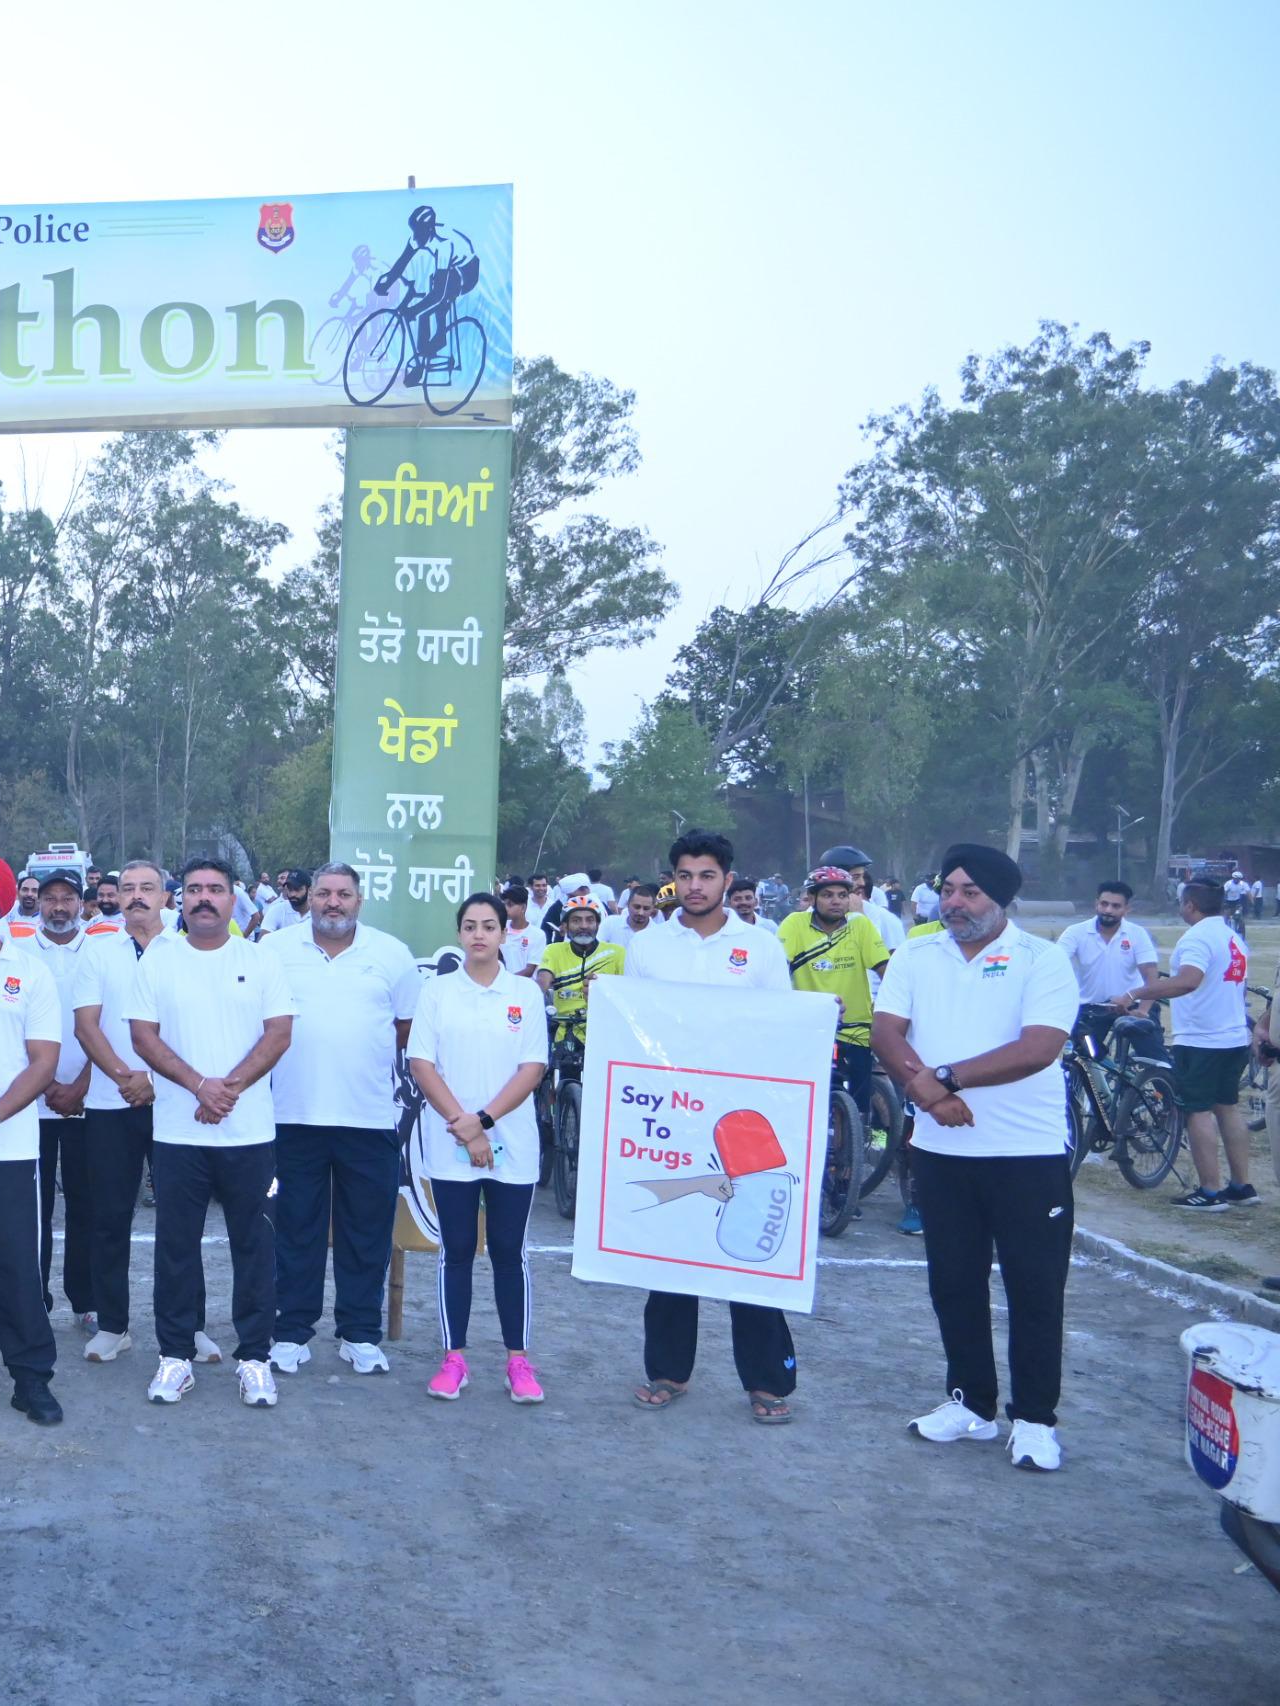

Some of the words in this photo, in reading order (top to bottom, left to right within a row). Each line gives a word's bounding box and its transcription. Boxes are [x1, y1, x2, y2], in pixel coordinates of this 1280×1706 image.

[359, 462, 495, 528] ਨਸ਼ਿਆਂ
[394, 556, 452, 593] ਨਾਲ
[358, 611, 406, 664] ਤੋੜੋ
[417, 616, 483, 666] ਯਾਰੀ
[378, 698, 459, 764] ਖੇਡਾਂ
[386, 793, 444, 830] ਨਾਲ
[408, 854, 475, 904] ਯਾਰੀ
[621, 1085, 664, 1112] Say
[671, 1090, 705, 1112] No
[642, 1117, 671, 1140] To
[619, 1137, 693, 1170] Drugs
[756, 1188, 787, 1254] DRUG
